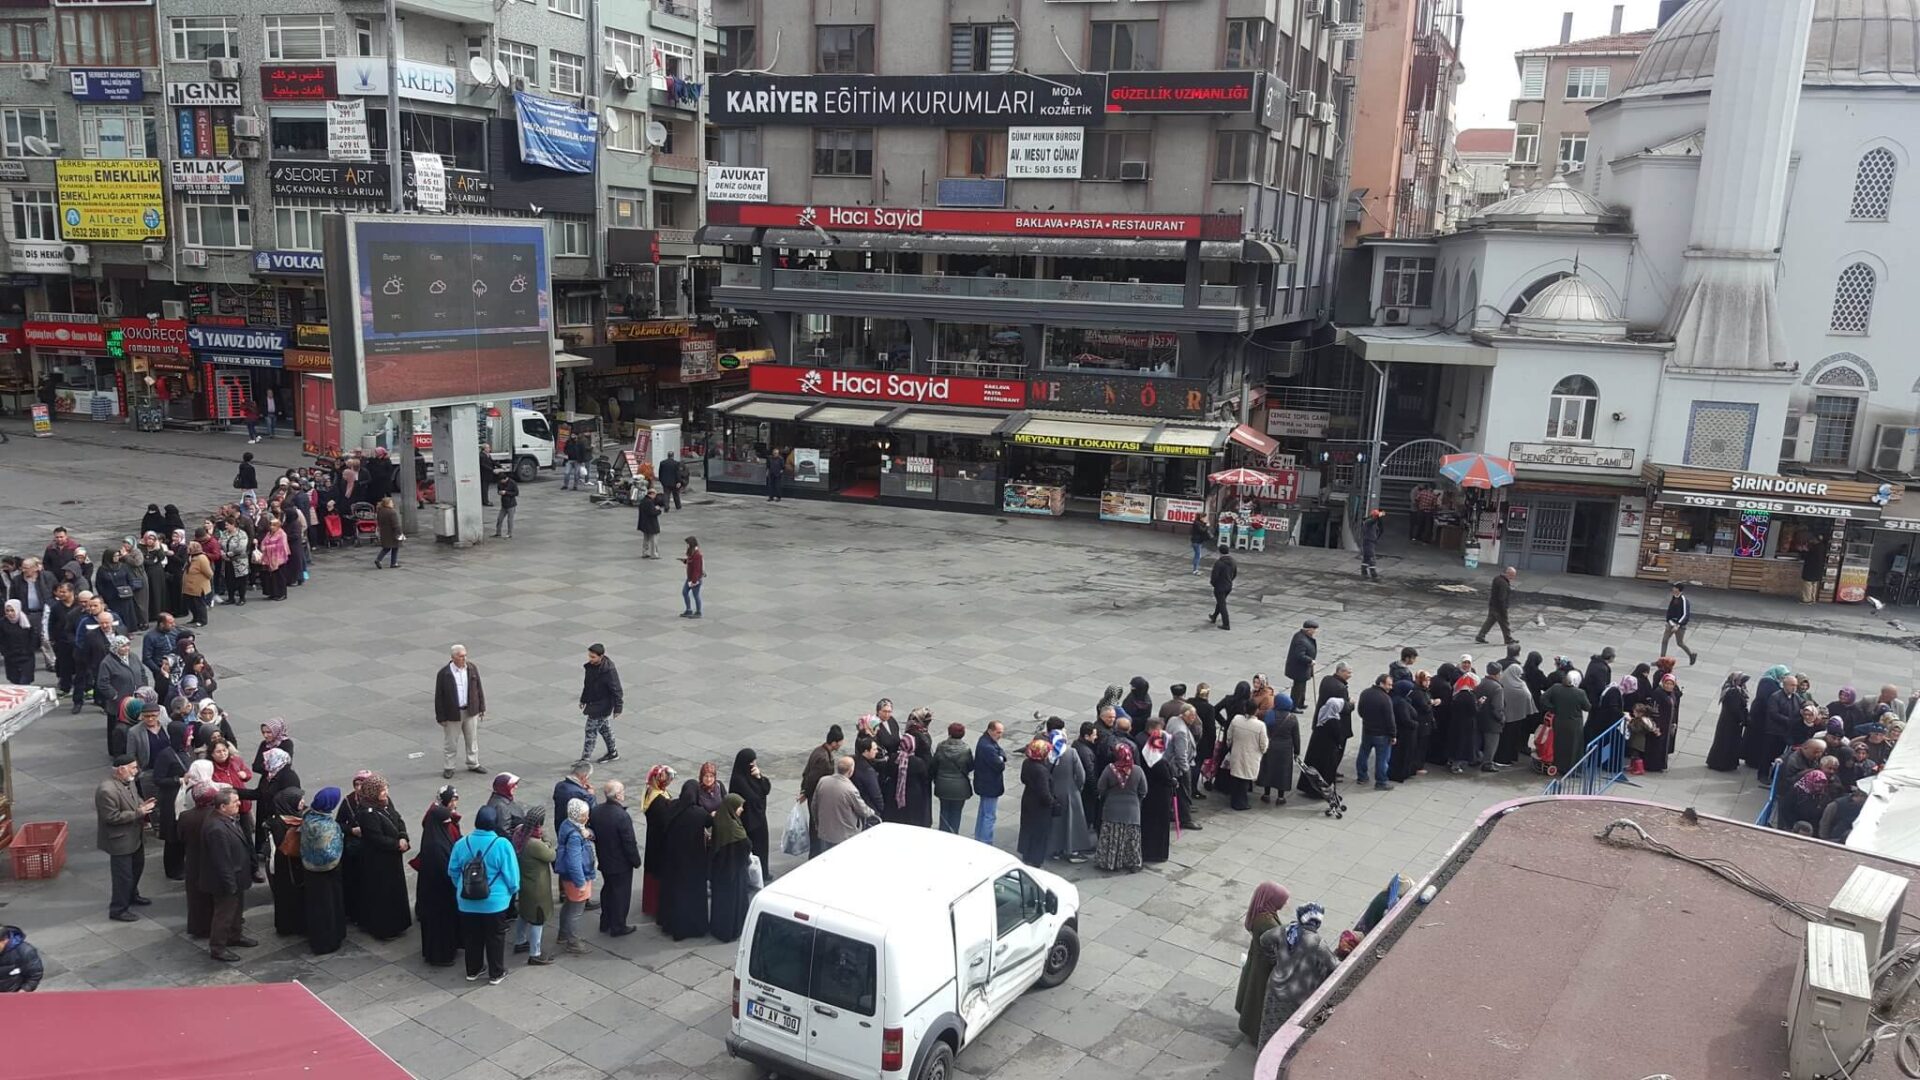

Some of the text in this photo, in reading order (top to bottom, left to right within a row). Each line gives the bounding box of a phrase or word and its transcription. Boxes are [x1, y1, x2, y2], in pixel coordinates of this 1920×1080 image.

[185, 83, 239, 99] GNR
[1051, 87, 1083, 97] MODA
[1111, 85, 1172, 100] GÜZELLİK
[726, 85, 1034, 114] KARİYER EĞİTİM KURUMLARI
[1062, 97, 1071, 106] &
[1040, 104, 1093, 115] KOZMETİK
[1033, 132, 1055, 141] HUKUK
[1010, 145, 1080, 161] AV. MESUT GÜNAY
[172, 161, 228, 174] EMLAK
[1015, 165, 1077, 173] TEL: 503 65 65
[284, 167, 374, 185] SECRET ART
[720, 169, 766, 181] AVUKAT
[275, 185, 292, 194] SAÇ
[293, 185, 327, 194] KAYNAK
[333, 186, 384, 196] SLARIUM
[715, 182, 762, 191] DENİZ GÖNER
[89, 214, 136, 225] Ali Tezel
[829, 207, 923, 230] Hacı Sayid
[1015, 217, 1186, 231] BAKLAVA PASTA RESTAURANT
[273, 254, 324, 269] VOLKA
[205, 331, 284, 350] YAVUZ DÖVİZ
[212, 355, 241, 364] YAVUZ
[297, 354, 332, 367] BAYBUR
[832, 371, 949, 402] Hacı Sayid
[1014, 434, 1140, 451] MEYDAN ET LOKANTASI
[1560, 455, 1592, 465] TOPEL
[1731, 476, 1828, 496] ŞİRİN DÖNER
[1684, 496, 1726, 506] TOST
[1793, 504, 1852, 517] DÖNER
[1167, 508, 1196, 522] DÖNE
[754, 1004, 764, 1017] 40
[783, 1015, 797, 1029] 100
